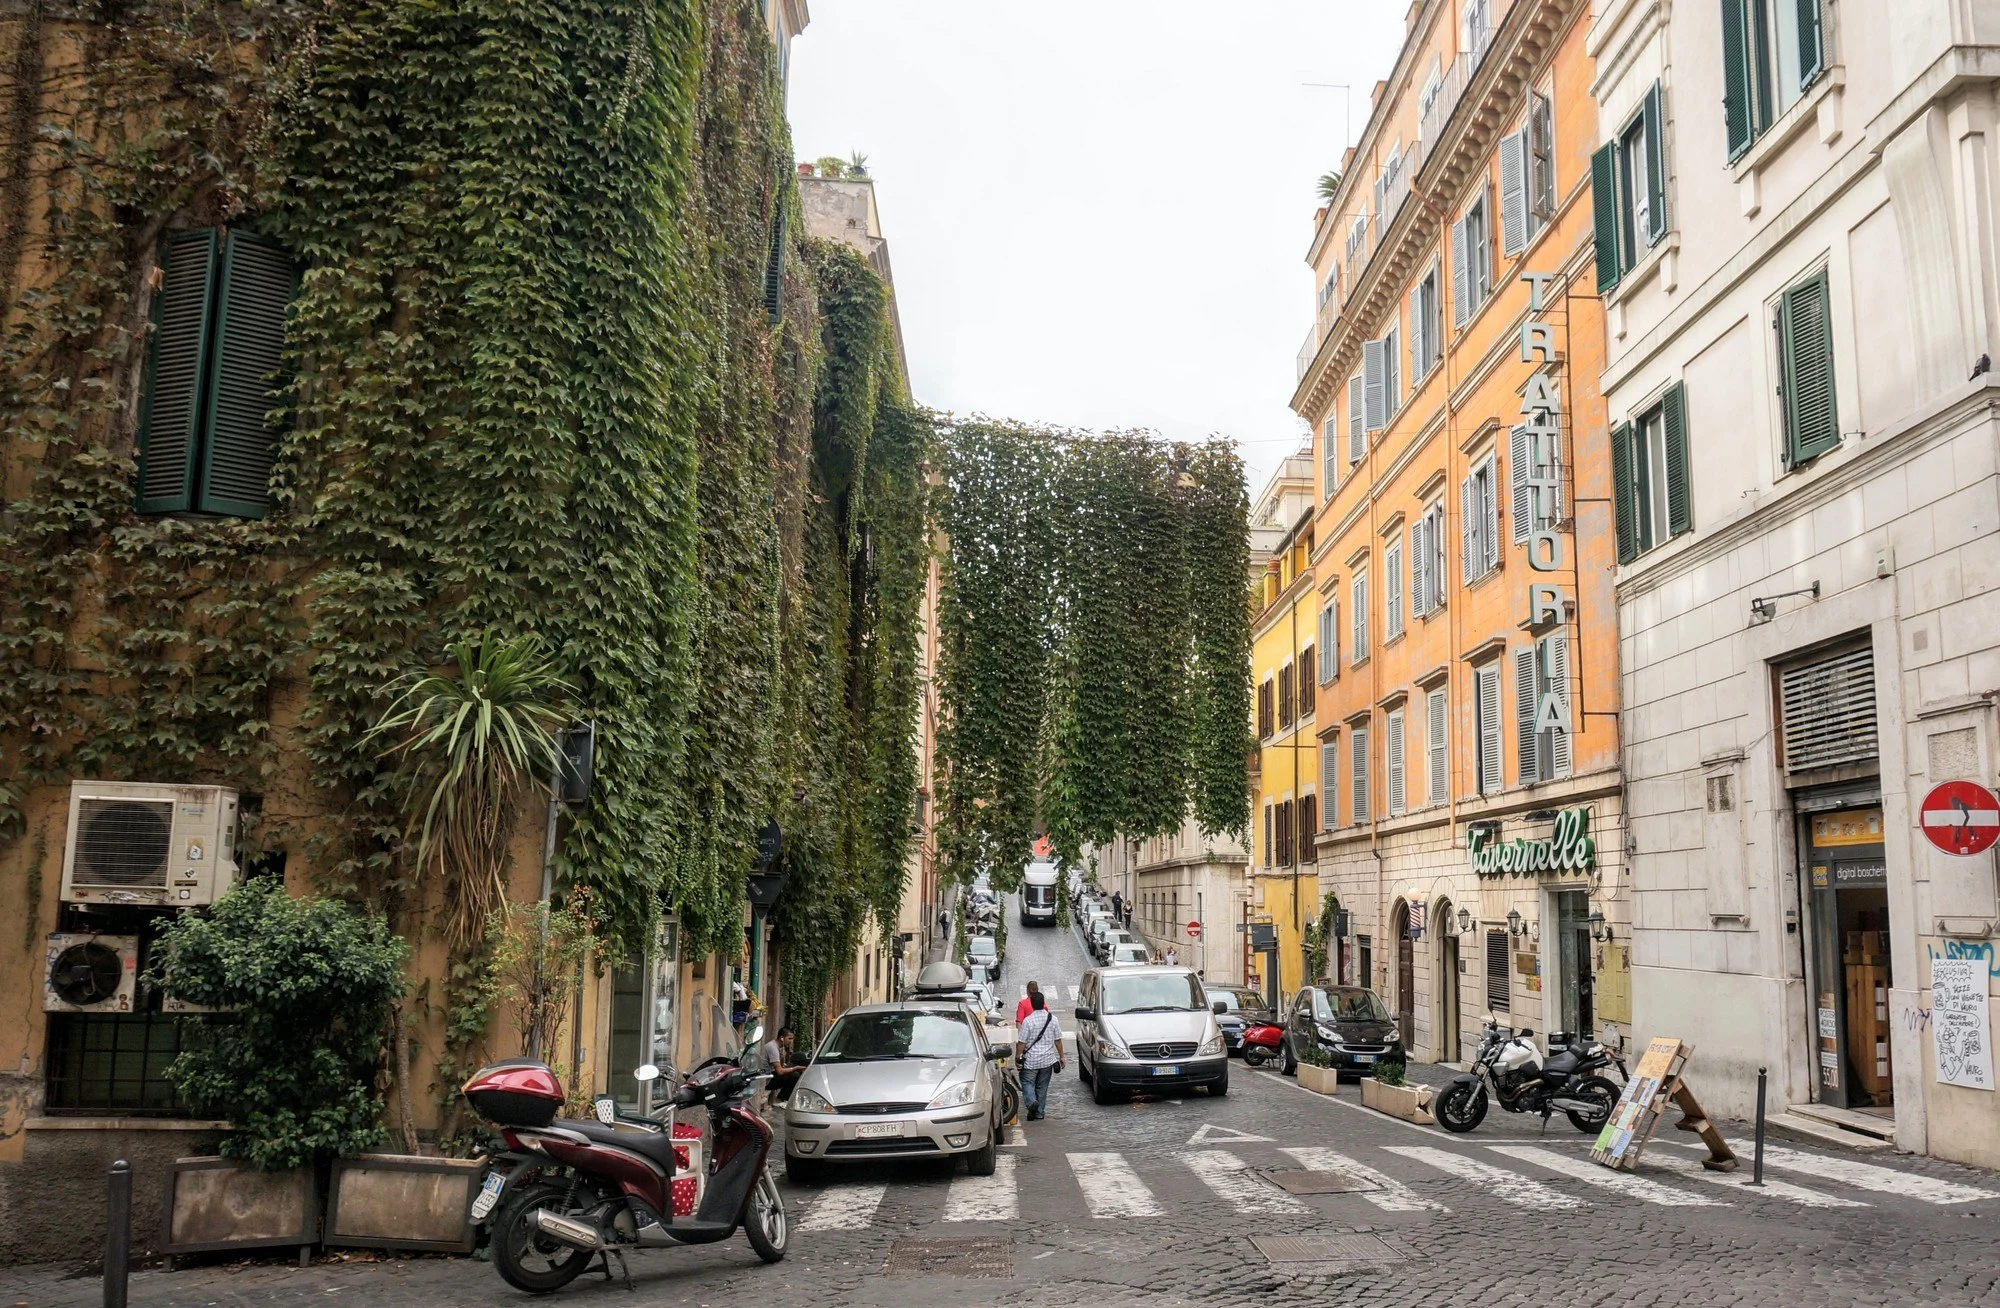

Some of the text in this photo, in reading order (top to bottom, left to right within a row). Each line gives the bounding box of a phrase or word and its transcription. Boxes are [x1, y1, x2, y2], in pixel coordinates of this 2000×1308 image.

[1520, 272, 1571, 734] TRATTORIA
[1467, 807, 1595, 874] Tavernelle
[1836, 865, 1856, 881] digital
